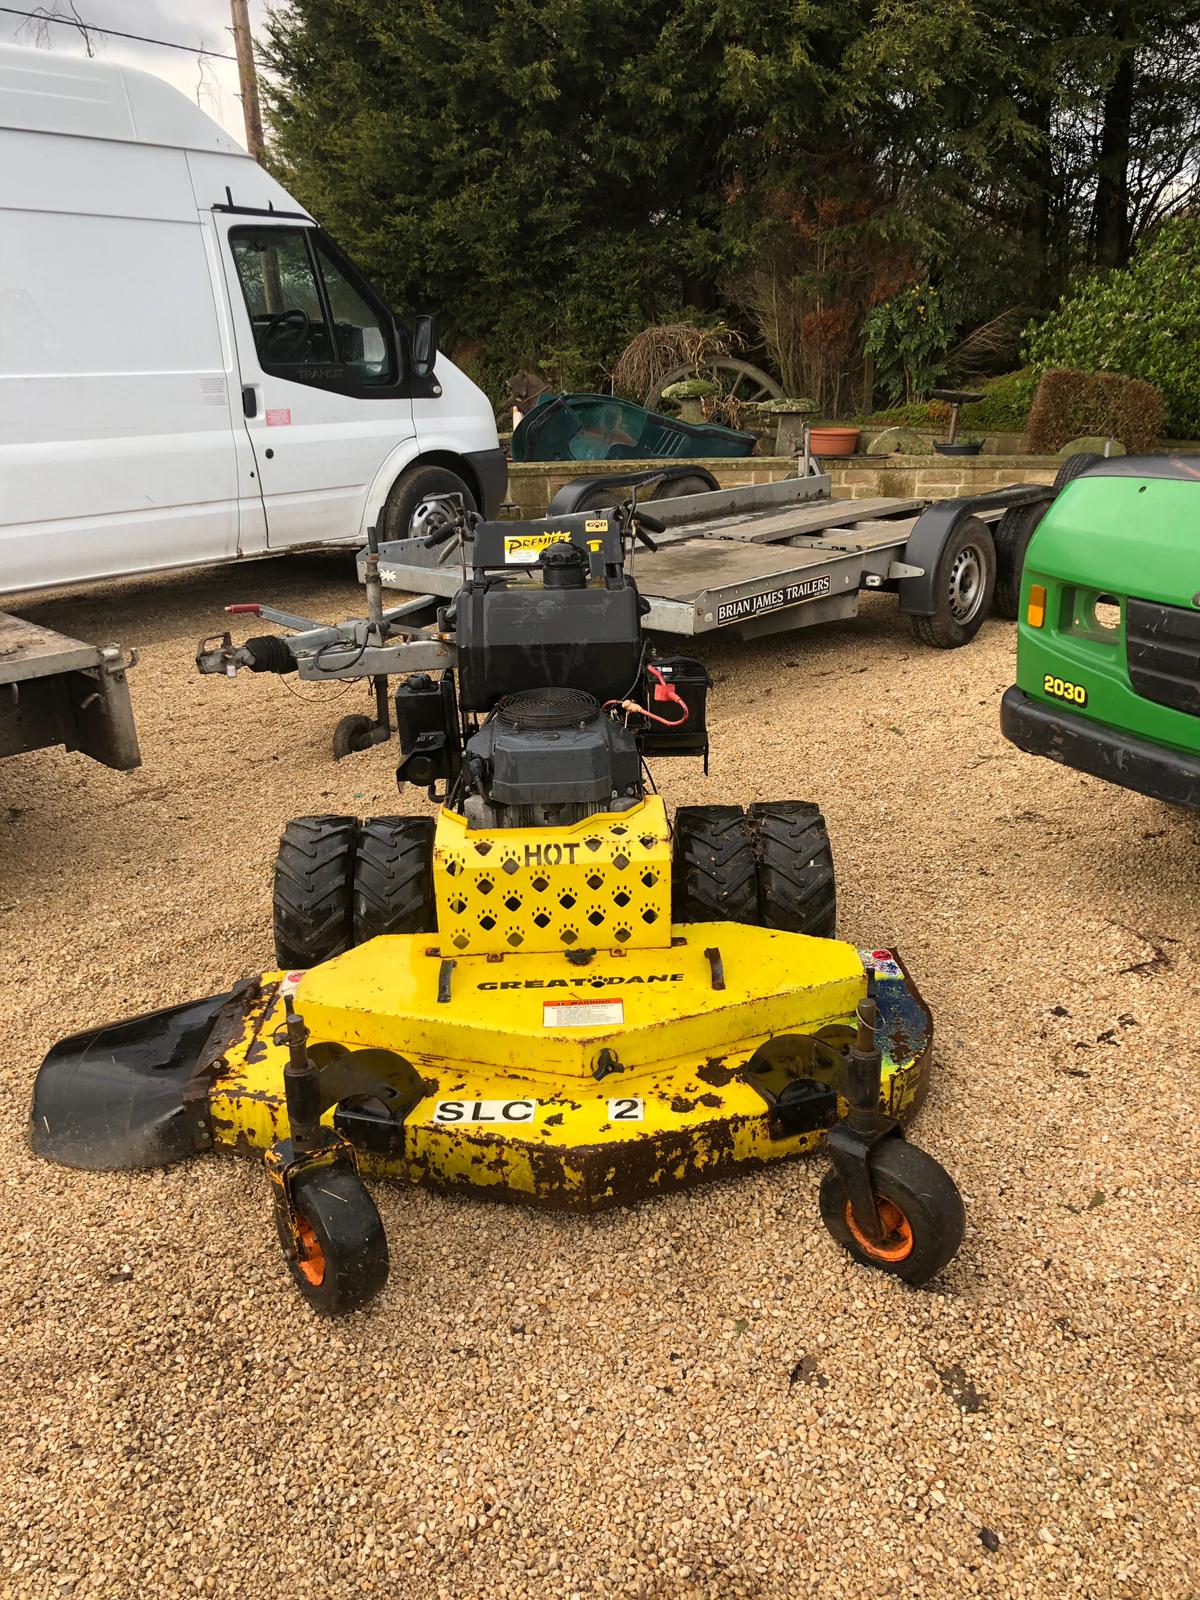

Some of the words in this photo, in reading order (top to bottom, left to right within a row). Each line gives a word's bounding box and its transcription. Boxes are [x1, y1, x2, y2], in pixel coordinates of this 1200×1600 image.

[297, 369, 345, 379] TRANSIT
[508, 535, 566, 554] PREMIER
[718, 600, 751, 620] BRIAN
[751, 590, 784, 612] JAMES
[785, 577, 829, 600] TRAILERS
[1044, 674, 1086, 704] 2030
[524, 842, 580, 867] HOT
[477, 978, 587, 991] GREAT
[606, 973, 685, 985] DANE
[436, 1100, 533, 1121] SLC
[614, 1099, 639, 1119] 2
